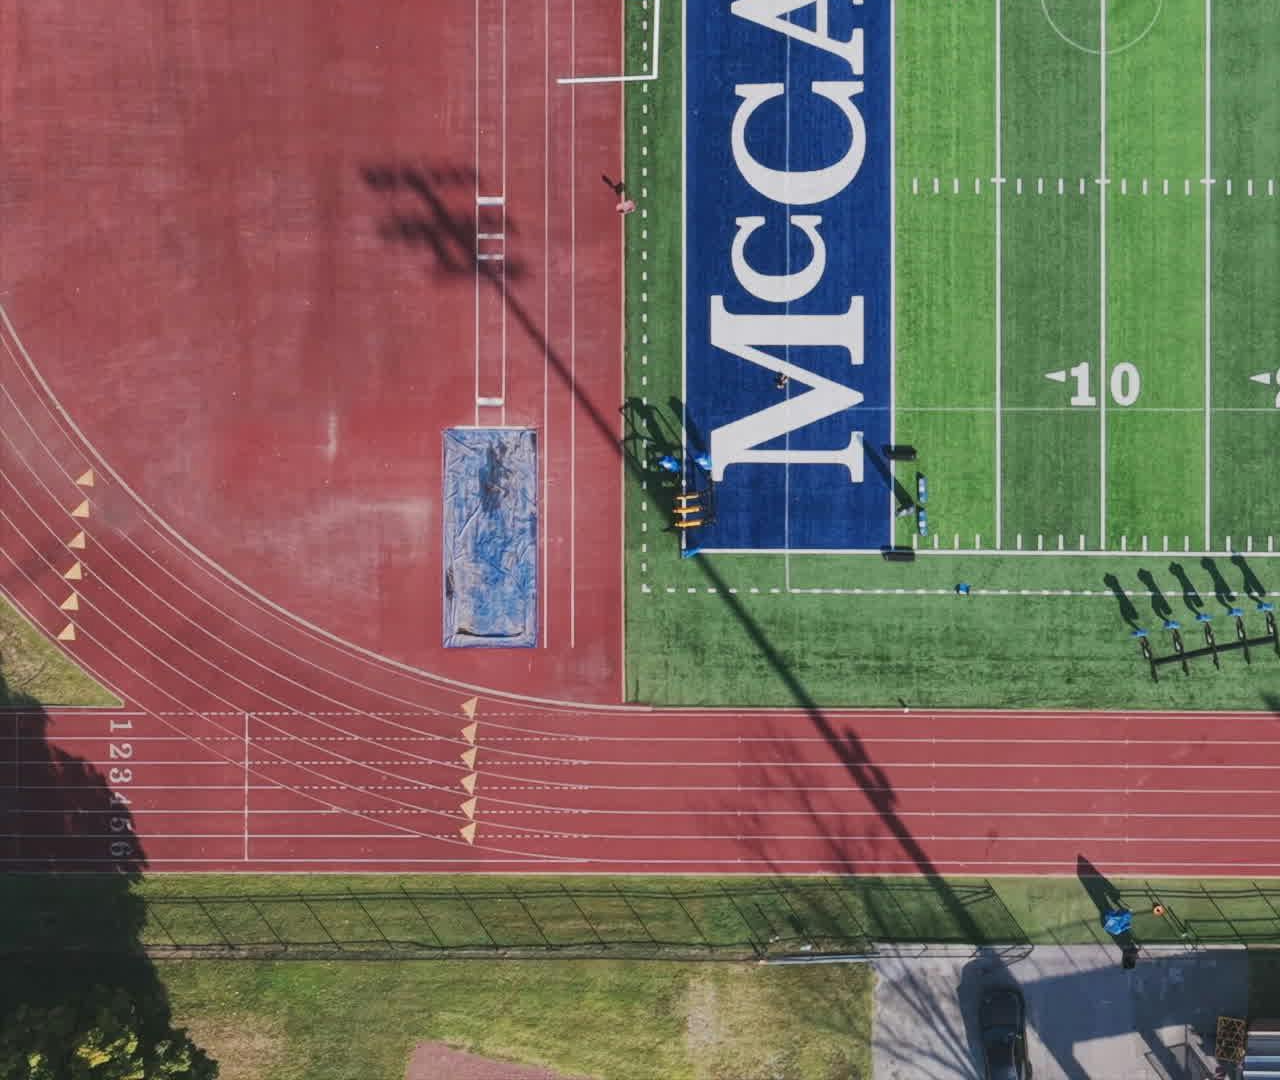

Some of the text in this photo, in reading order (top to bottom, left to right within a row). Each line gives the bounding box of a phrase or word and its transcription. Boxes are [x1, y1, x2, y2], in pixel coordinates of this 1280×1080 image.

[1070, 362, 1140, 407] 10
[110, 719, 133, 856] 1 2 3 4 5 6
